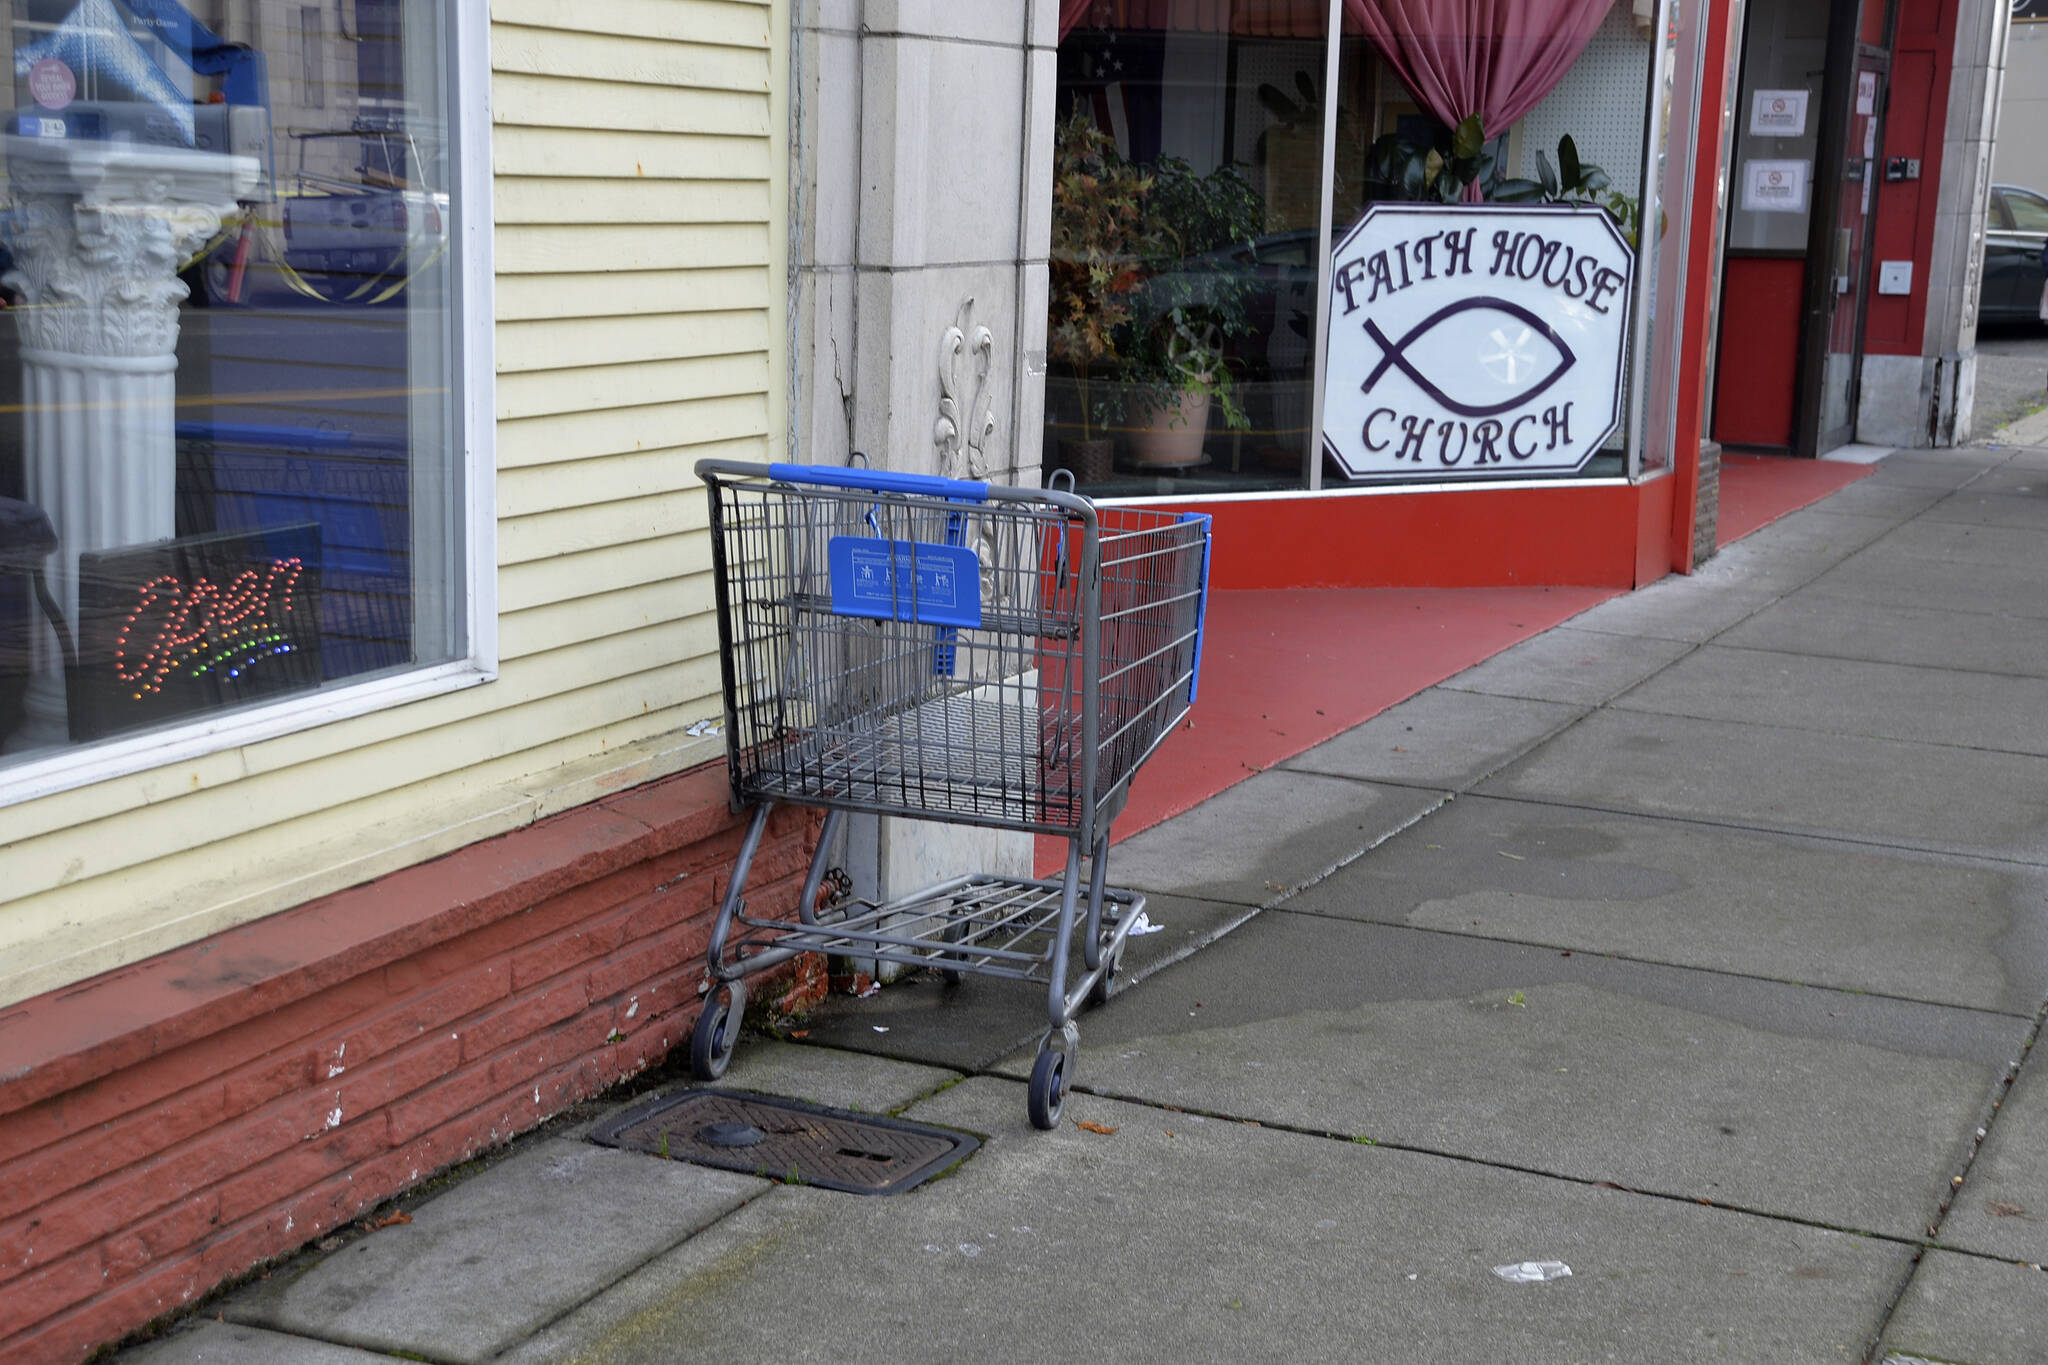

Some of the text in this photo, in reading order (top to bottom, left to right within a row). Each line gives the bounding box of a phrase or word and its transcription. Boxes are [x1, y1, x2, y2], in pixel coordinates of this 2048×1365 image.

[1335, 227, 1625, 316] FAITH HOUSE
[1361, 401, 1574, 466] CHURCH
